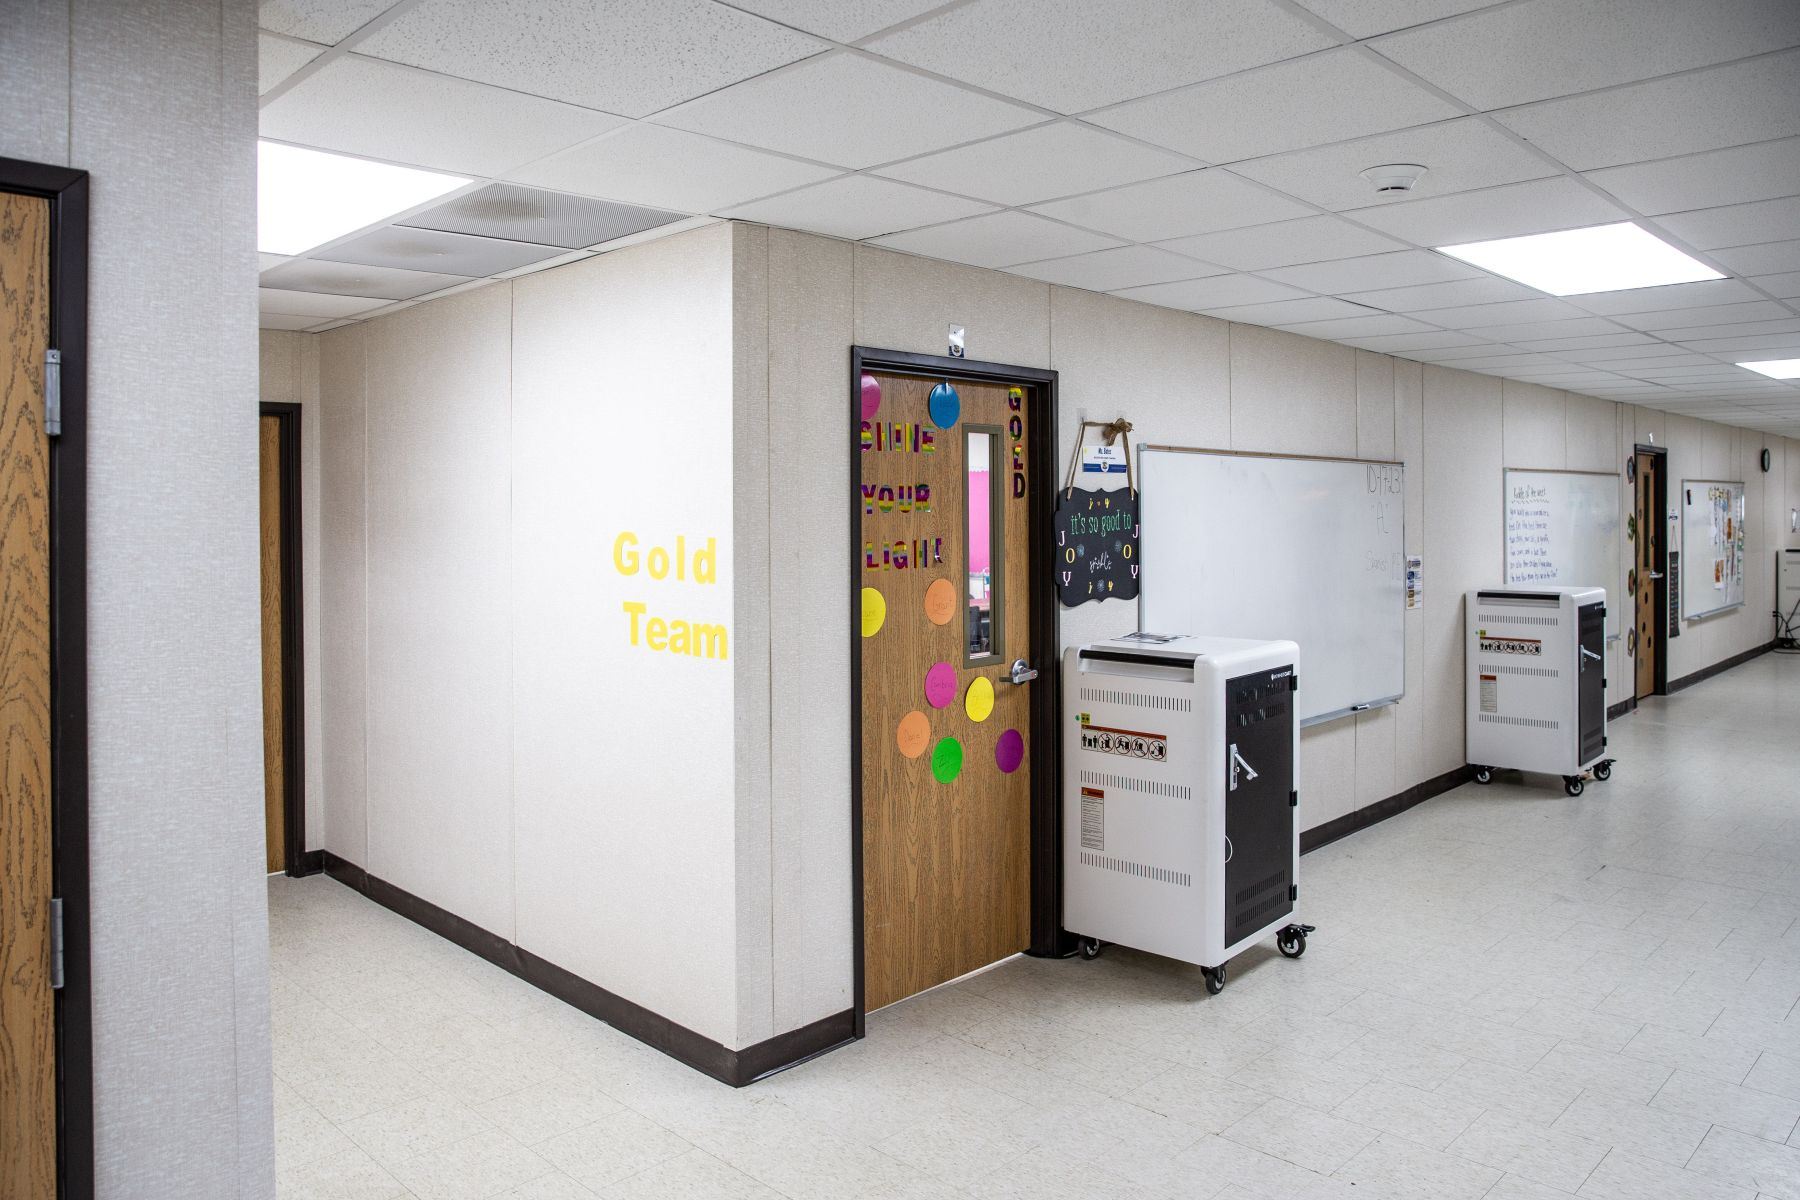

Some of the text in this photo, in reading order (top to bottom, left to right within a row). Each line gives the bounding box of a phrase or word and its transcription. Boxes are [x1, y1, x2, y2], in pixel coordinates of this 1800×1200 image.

[861, 420, 936, 454] SHINE
[1008, 386, 1025, 498] GOLD
[861, 484, 932, 514] YOUR
[1070, 509, 1132, 537] it's so good to
[613, 530, 716, 584] Gold
[866, 537, 943, 573] LIGHT
[622, 601, 728, 660] Team
